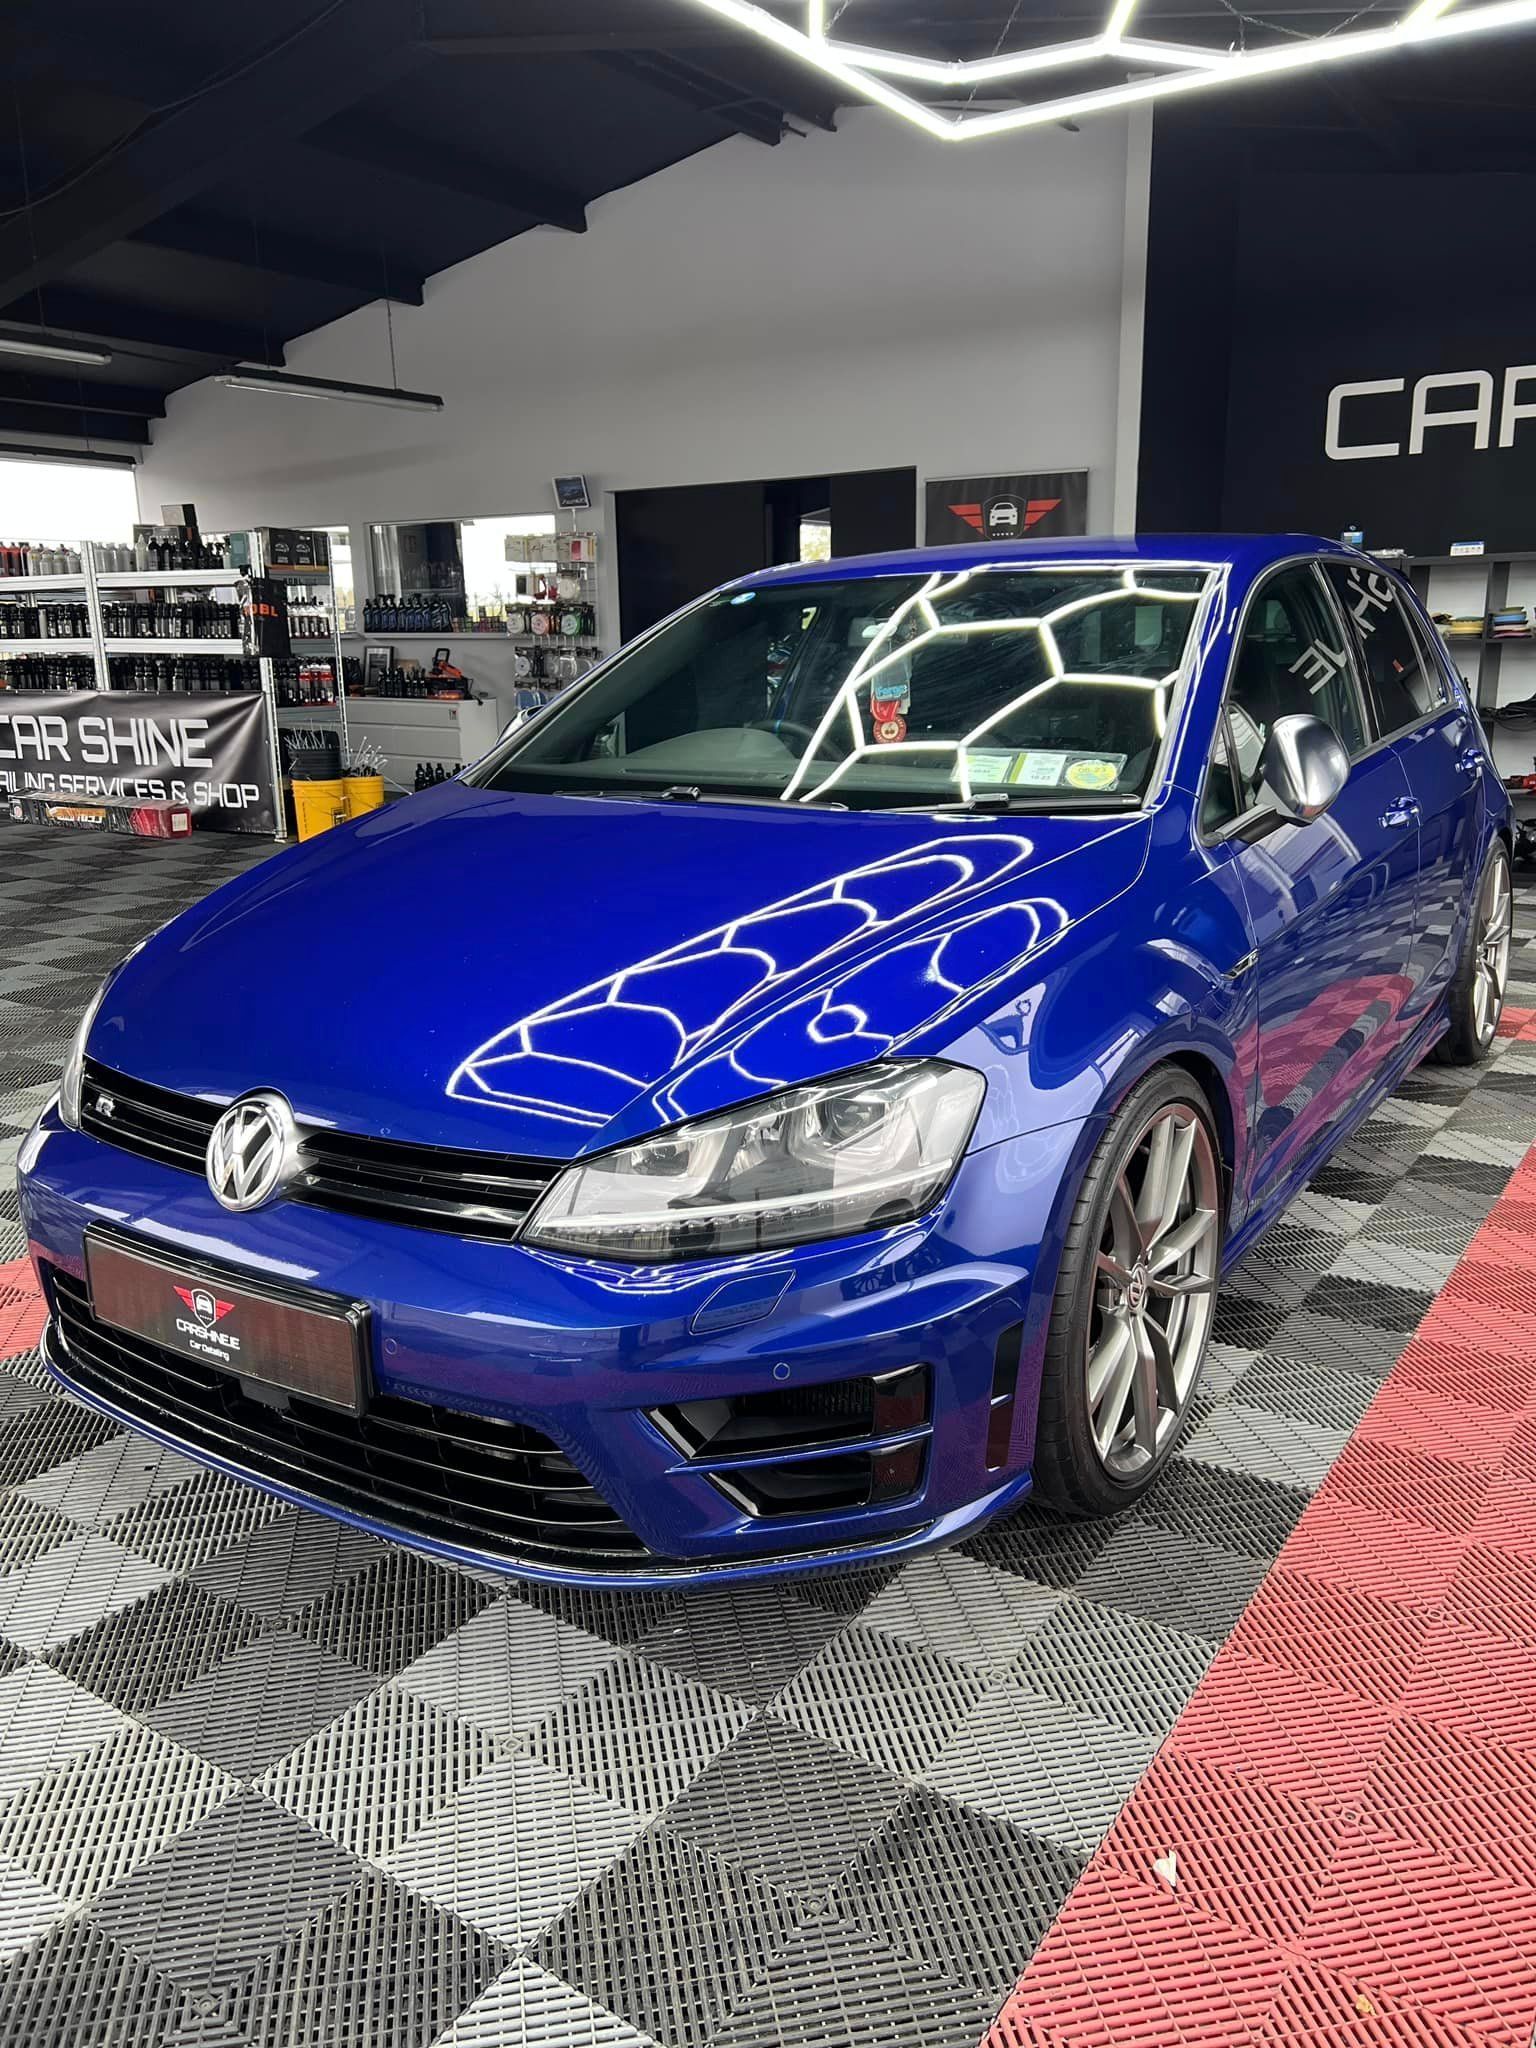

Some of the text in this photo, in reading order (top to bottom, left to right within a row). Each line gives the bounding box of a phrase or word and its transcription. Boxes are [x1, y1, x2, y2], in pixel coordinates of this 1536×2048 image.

[79, 716, 213, 768] SHINE
[171, 780, 188, 803] &
[193, 782, 260, 809] SHOP
